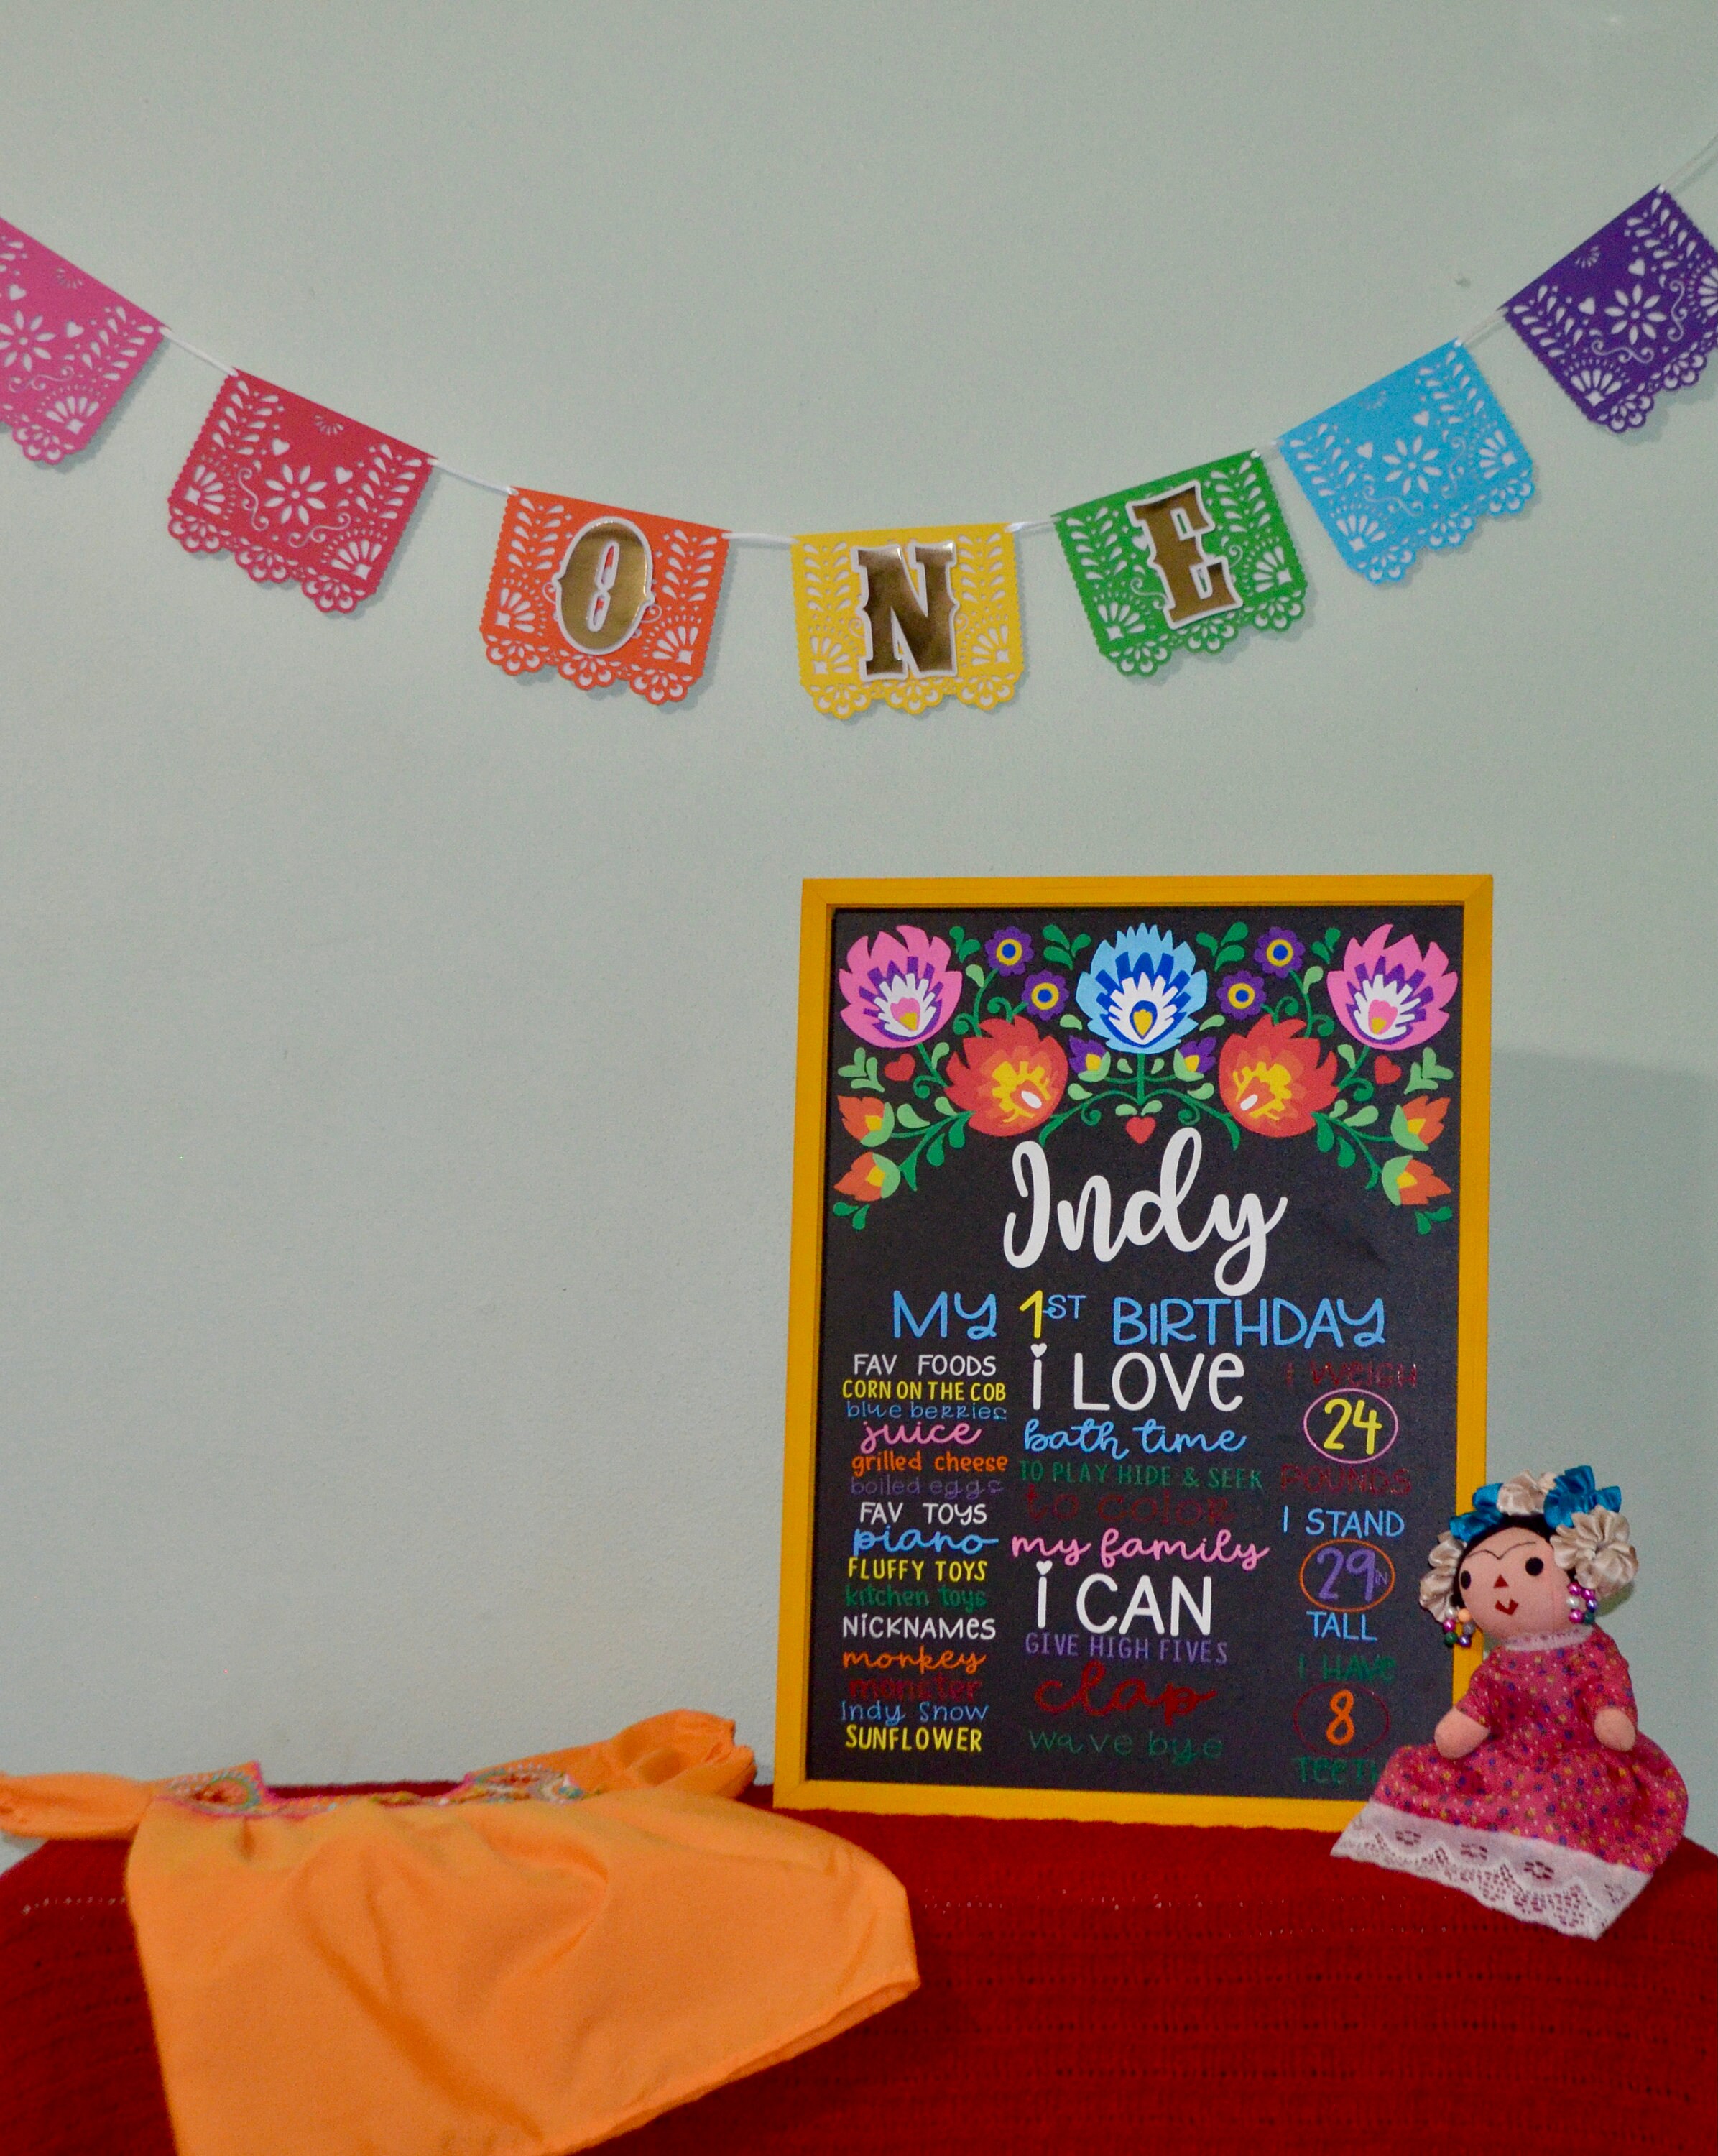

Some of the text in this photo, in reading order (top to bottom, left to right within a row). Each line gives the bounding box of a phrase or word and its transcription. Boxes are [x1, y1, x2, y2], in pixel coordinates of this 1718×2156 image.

[1003, 1127, 1288, 1296] Indy
[892, 1290, 997, 1340] MY
[1112, 1296, 1386, 1348] BIRTHDAY
[854, 1354, 997, 1376] FAV FOODS
[842, 1379, 1006, 1402] CORN ON THE COB
[846, 1401, 902, 1419] blue
[860, 1421, 982, 1455] juice
[1024, 1417, 1247, 1460] bath time
[1323, 1397, 1382, 1455] 24
[851, 1450, 1008, 1478] grilled cheese
[1019, 1460, 1045, 1483] TO
[1052, 1461, 1110, 1483] PLAY
[1117, 1464, 1171, 1486] HIDE
[1208, 1468, 1262, 1489] SEEK
[1280, 1463, 1412, 1496] POUNDS
[851, 1475, 1005, 1500] boiled eggs
[1025, 1483, 1079, 1522] to
[860, 1502, 987, 1525] FAV TOYS
[1282, 1505, 1405, 1538] I STAND
[852, 1525, 999, 1556] piano
[1012, 1527, 1270, 1572] my family
[847, 1557, 988, 1582] FLUFFY TOYS
[844, 1584, 988, 1613] kitchen toys
[1076, 1572, 1212, 1636] CAN
[1306, 1611, 1377, 1641] TALL
[842, 1644, 987, 1674] monkey
[1025, 1631, 1228, 1664] GIVE HIGH FIVES
[849, 1672, 983, 1702] monster
[1033, 1659, 1216, 1726] clap
[841, 1700, 989, 1725] Indy Snow
[1326, 1689, 1355, 1747] 8
[844, 1724, 983, 1753] SUNFLOWER
[1029, 1730, 1224, 1766] wave bye
